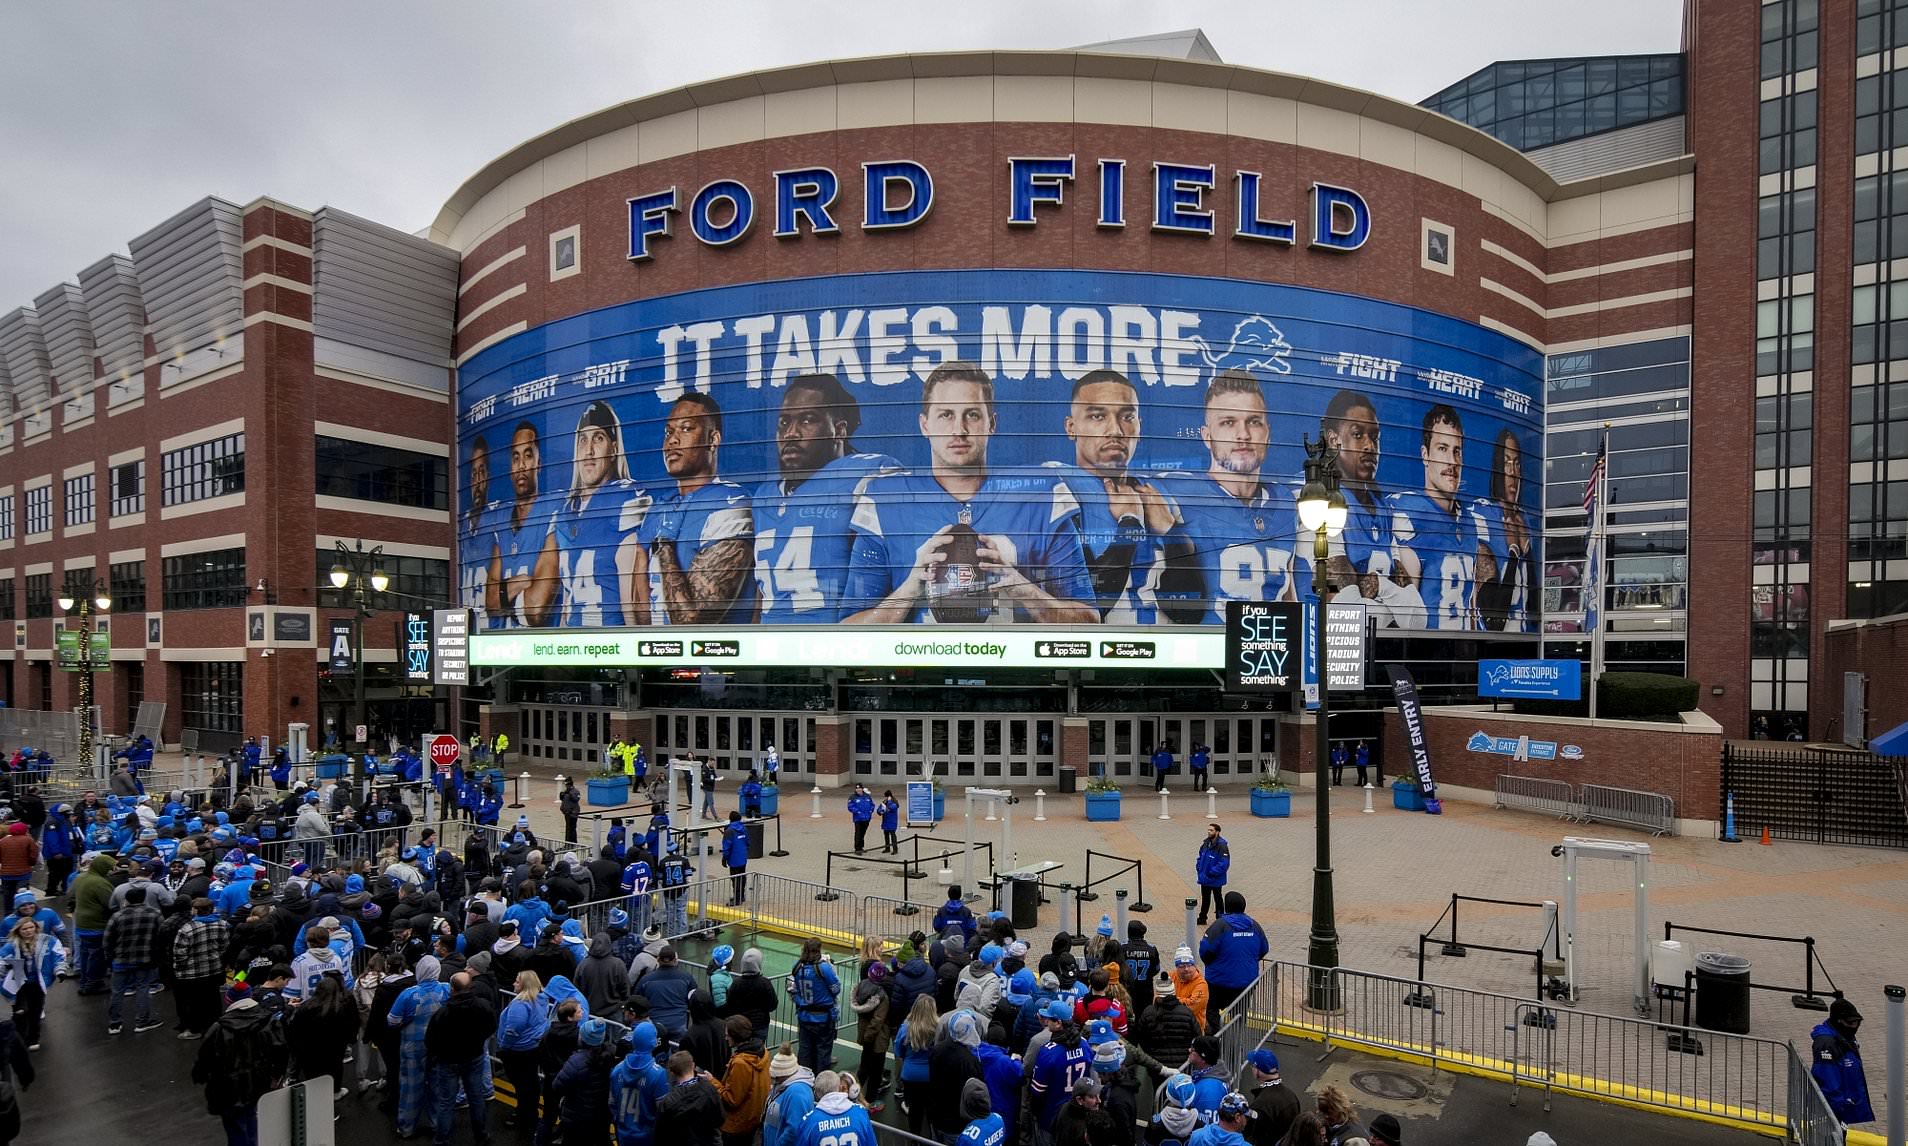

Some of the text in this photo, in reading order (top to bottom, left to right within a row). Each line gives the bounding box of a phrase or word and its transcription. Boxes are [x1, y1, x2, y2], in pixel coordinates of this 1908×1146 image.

[626, 154, 1371, 263] FORD FIELD
[654, 304, 1202, 402] IT TAKES MORE
[584, 359, 630, 388] GRIT
[1336, 352, 1401, 382] FIGHT
[1428, 368, 1484, 399] HEART
[1242, 605, 1268, 618] if you
[1329, 610, 1360, 620] REPORT
[408, 621, 428, 643] SEE
[1240, 616, 1288, 642] SEE
[1327, 623, 1360, 632] YTHING
[333, 635, 350, 657] A
[1242, 641, 1286, 652] something
[1327, 636, 1360, 646] PICIOUS
[533, 643, 620, 658] lend. earn. repeat
[652, 647, 666, 656] App
[704, 647, 737, 656] Google Play
[894, 641, 1007, 659] download today
[1054, 648, 1068, 656] App
[1116, 648, 1152, 657] Google Play
[1328, 649, 1360, 658] TADIUM
[408, 650, 429, 672] SAY
[1240, 650, 1288, 676] SAY
[1326, 662, 1360, 672] ECURITY
[1240, 676, 1286, 686] something
[1330, 676, 1360, 685] POLICE
[1510, 666, 1558, 680] LIONS SUPPLY
[1402, 700, 1422, 746] ENTRY
[432, 744, 458, 756] STOP
[1498, 735, 1528, 762] GATE A
[1414, 750, 1432, 793] EARLY
[666, 866, 684, 886] 14
[632, 876, 648, 894] 17
[1066, 1048, 1084, 1060] ALLEN
[1064, 1062, 1086, 1092] 17
[620, 1087, 640, 1122] 14
[818, 1116, 850, 1132] BRANCH
[962, 1125, 981, 1140] 20
